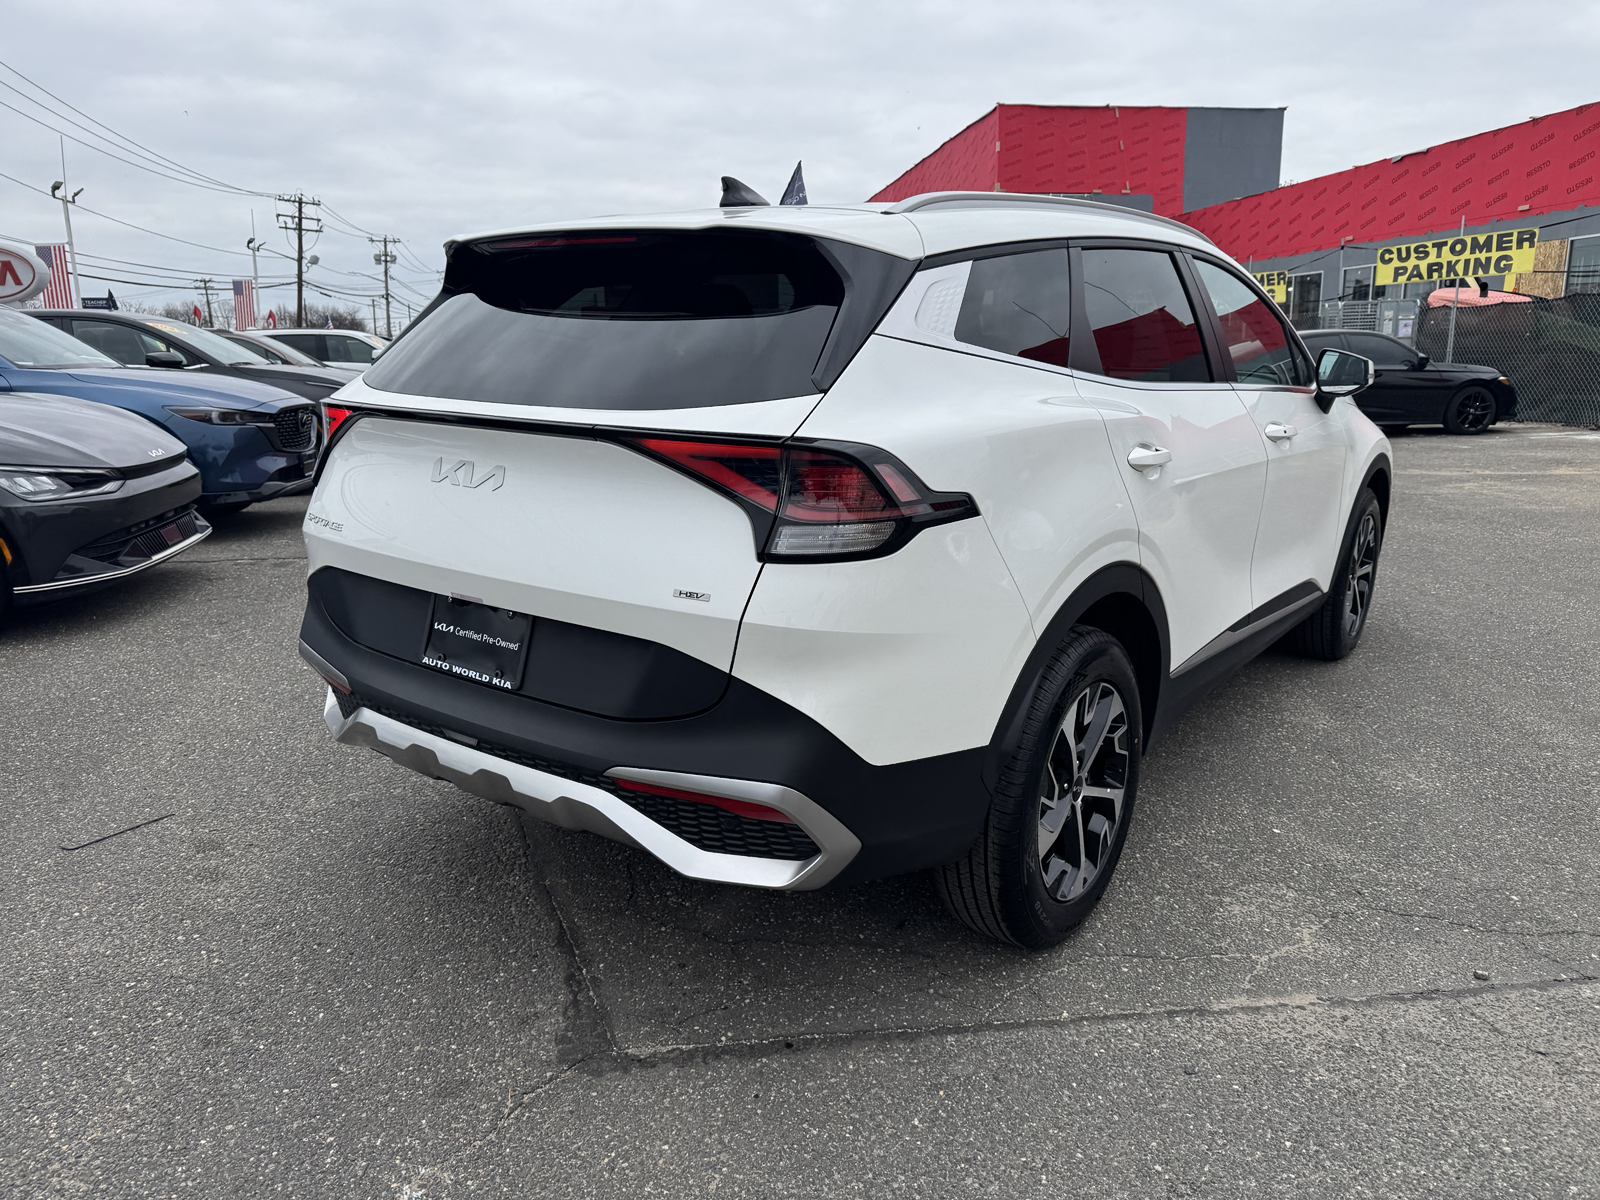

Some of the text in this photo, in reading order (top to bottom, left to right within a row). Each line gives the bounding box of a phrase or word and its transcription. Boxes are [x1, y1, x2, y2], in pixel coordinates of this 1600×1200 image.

[1531, 134, 1554, 151] RESISTO
[1492, 143, 1513, 160] RESISTO
[1456, 153, 1476, 169] RESISTO
[1527, 160, 1550, 178] RESISTO
[1569, 151, 1595, 170] RESISTO
[1452, 178, 1472, 193] RESISTO
[1488, 169, 1509, 185] RESISTO
[1567, 177, 1593, 194] RESISTO
[1486, 192, 1507, 208] RESISTO
[1525, 185, 1548, 201] RESISTO
[1379, 229, 1537, 265] CUSTOMER
[1393, 254, 1514, 283] PARKING
[431, 457, 506, 492] KIA
[678, 590, 705, 599] HEV
[434, 622, 518, 651] KIA Certified Pre-Owned
[422, 656, 512, 690] AUTO WORLD KIA
